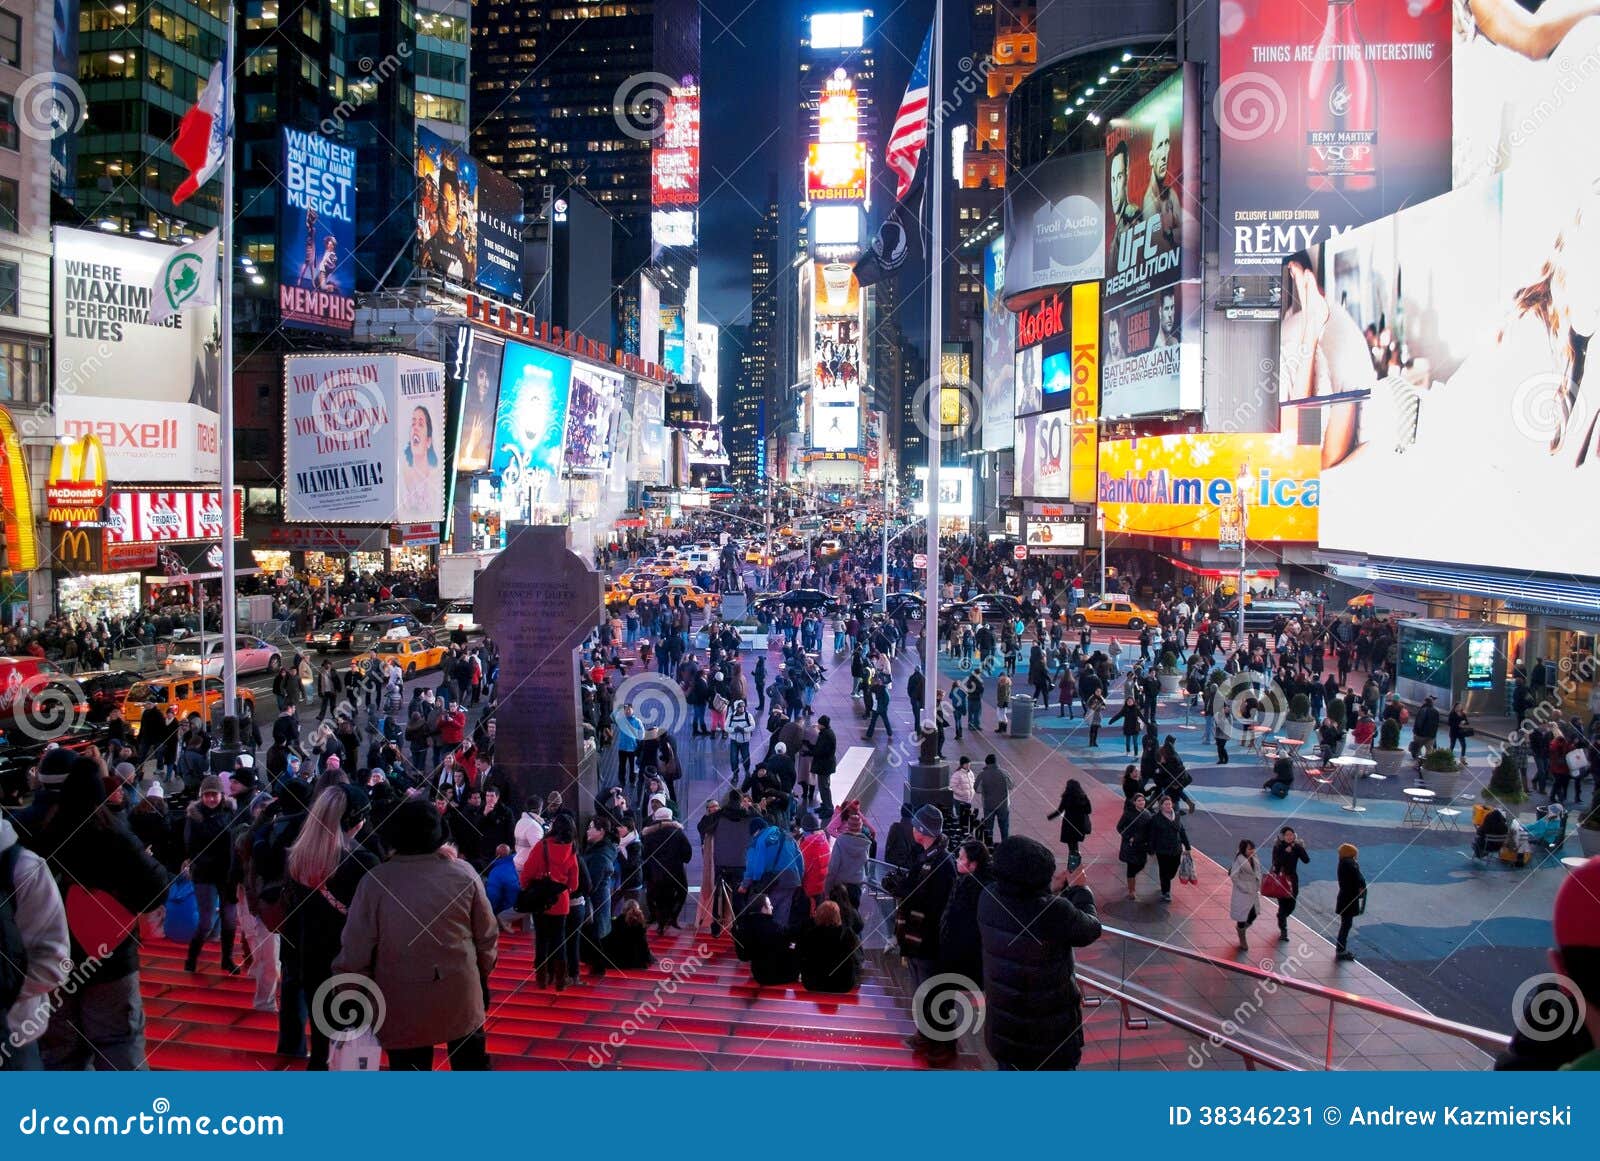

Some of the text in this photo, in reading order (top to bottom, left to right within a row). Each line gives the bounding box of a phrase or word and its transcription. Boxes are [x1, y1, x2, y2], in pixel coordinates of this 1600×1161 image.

[1252, 47, 1290, 62] THINGS
[1294, 45, 1314, 61] ARE
[284, 127, 355, 168] WINNER!
[1312, 145, 1370, 161] VSOP
[288, 161, 352, 205] BEST
[809, 188, 865, 200] TOSHIBA
[287, 189, 352, 222] MUSICAL
[1234, 210, 1319, 221] EXCLUSIVE LIMITED EDITION
[480, 210, 522, 242] MICHAEL
[1036, 223, 1061, 236] Tivoli
[1064, 215, 1098, 230] Audio
[1233, 222, 1320, 253] RÉMY
[1117, 213, 1161, 272] UFC
[65, 259, 122, 282] WHERE
[1106, 247, 1180, 297] RESOLUTION
[66, 276, 153, 309] MAXIM
[280, 284, 355, 322] MEMPHIS
[66, 318, 123, 342] LIVES
[1018, 293, 1064, 348] Kodak
[293, 363, 380, 395] YOU ALREADY
[1104, 355, 1149, 379] SATURDAY
[1073, 343, 1095, 447] Kodak
[64, 419, 178, 449] maxell
[317, 429, 371, 455] LOVE IT!
[49, 488, 103, 498] McDonald's
[296, 461, 384, 495] MAMMA MIA!
[1100, 469, 1320, 506] Bank of Ameica
[152, 514, 177, 525] FRIDAYS
[203, 513, 223, 524] FRIDAY
